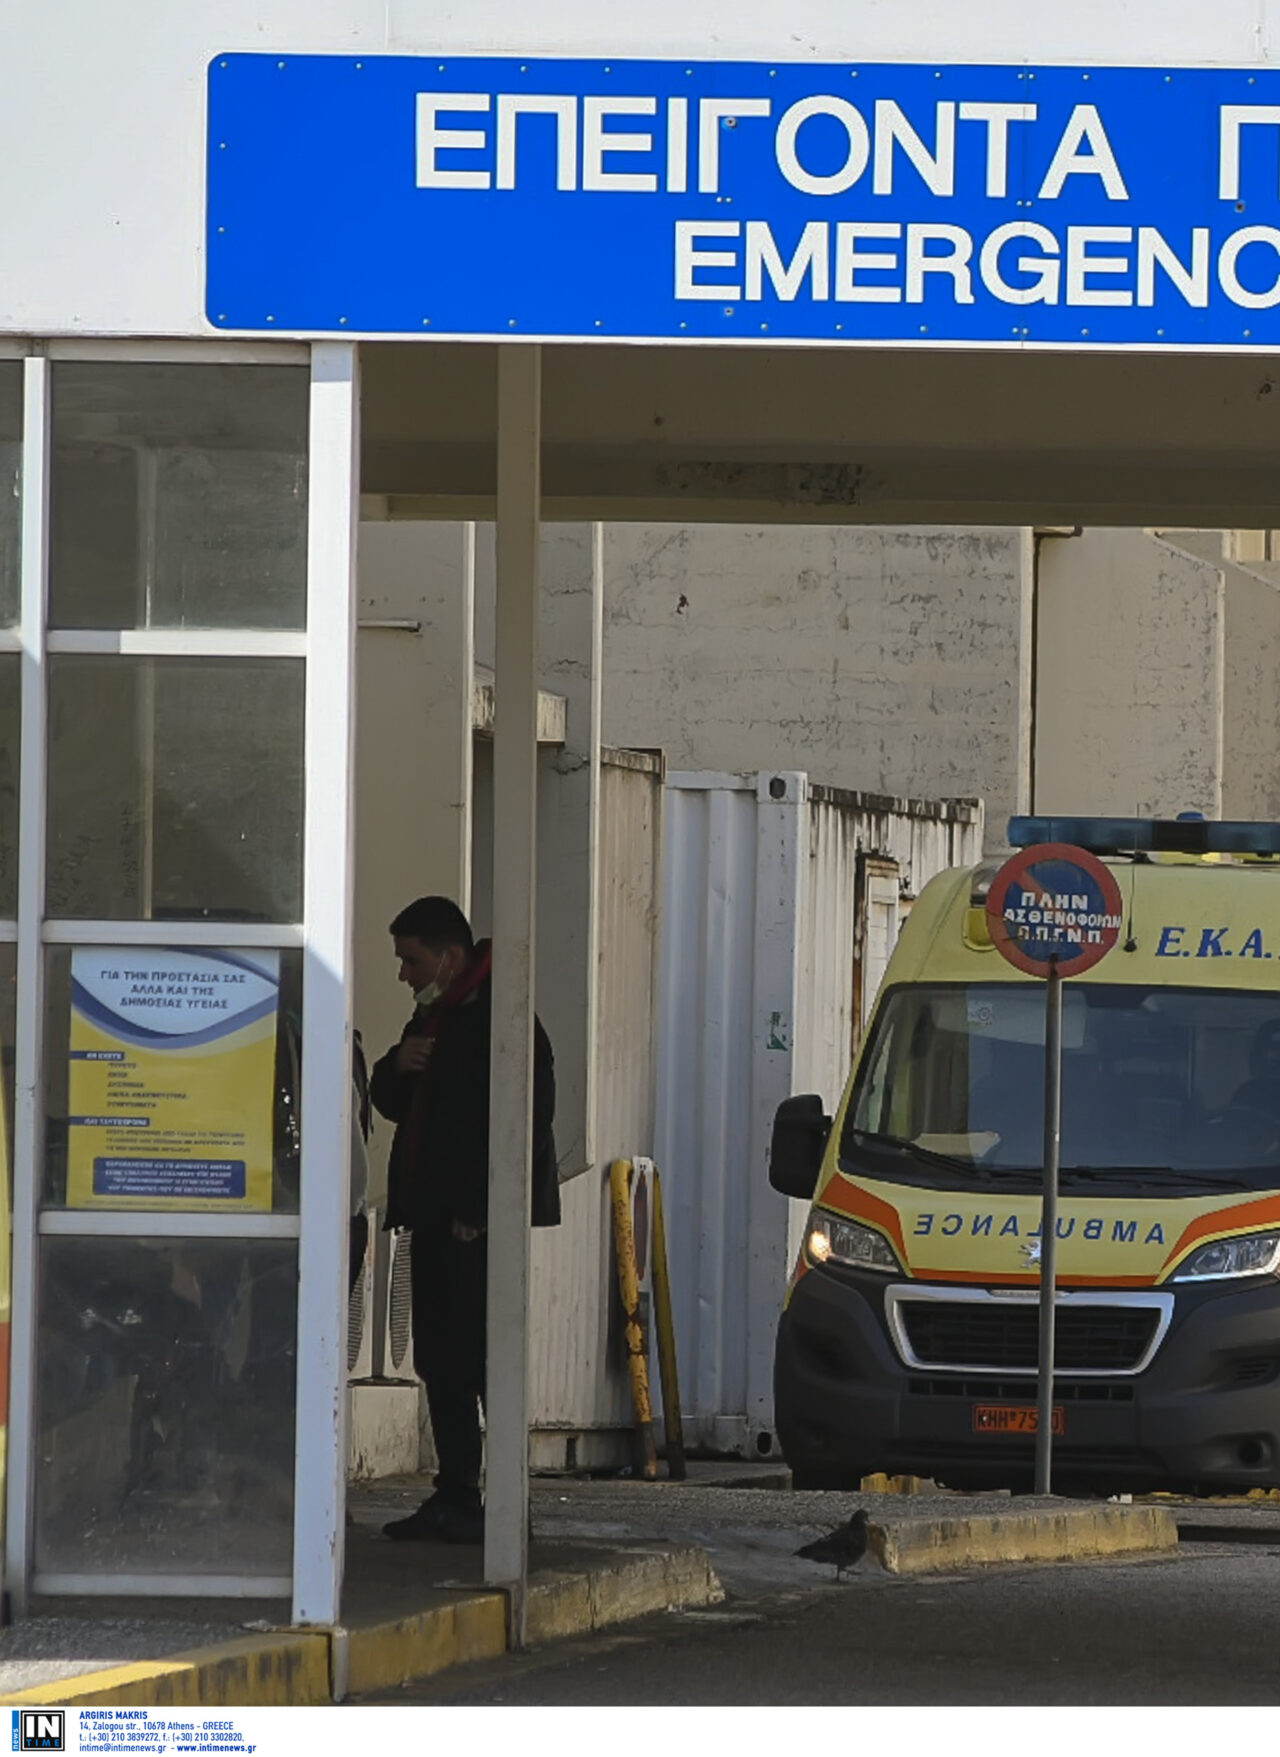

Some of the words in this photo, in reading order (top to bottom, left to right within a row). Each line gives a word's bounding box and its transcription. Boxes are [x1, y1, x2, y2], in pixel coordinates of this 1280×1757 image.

[415, 92, 1129, 200] ΕΠΕΙΓΟΝΤΑ
[1021, 892, 1089, 910] ΠΛΗΝ
[101, 970, 119, 980] ΓΙΑ
[124, 971, 148, 981] ΤΗΝ
[152, 972, 219, 983] ΠΡΟΣΤΑΣΙΑ
[223, 974, 246, 983] ΣΑΣ
[131, 984, 163, 994] ΑΛΛΑ
[167, 985, 188, 995] ΚΑΙ
[120, 997, 182, 1008] ΔΗΜΟΣΙΑΣ
[186, 999, 228, 1009] ΥΓΕΙΑΣ
